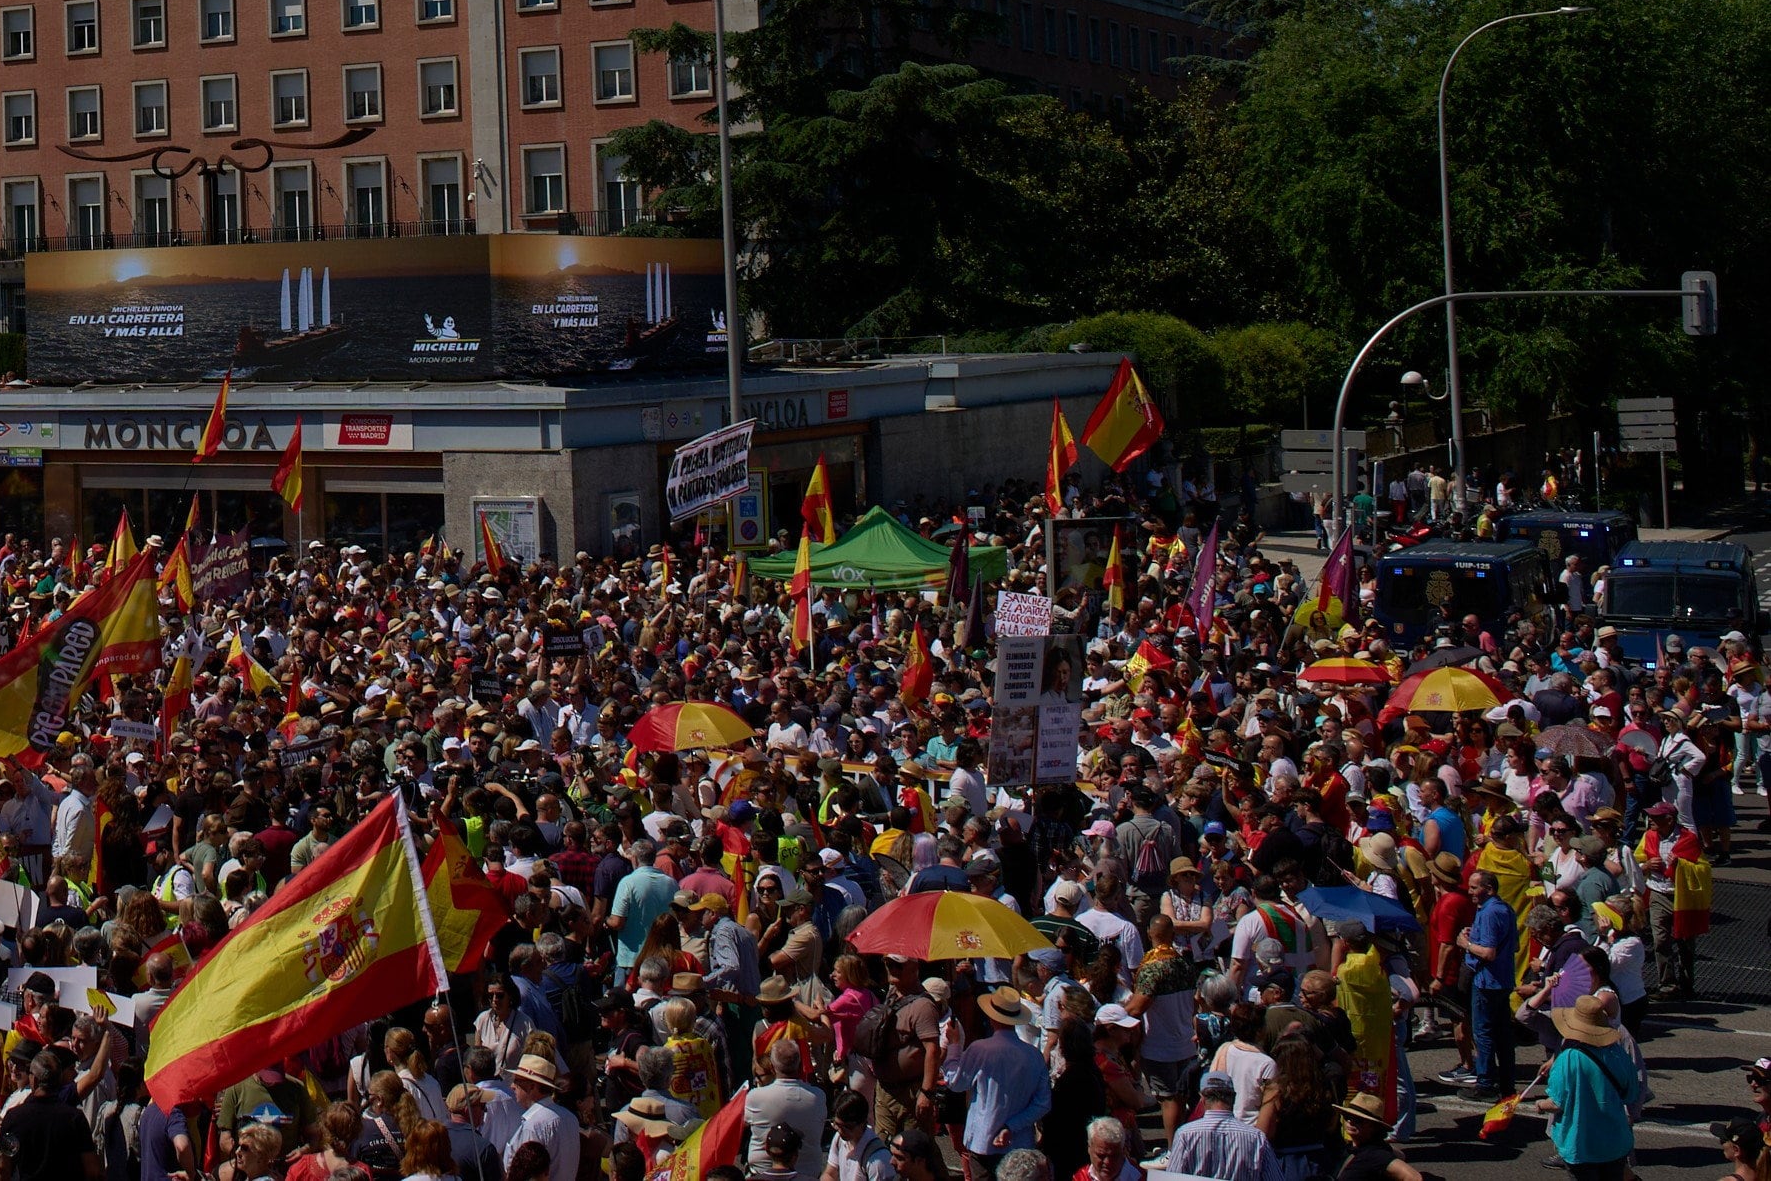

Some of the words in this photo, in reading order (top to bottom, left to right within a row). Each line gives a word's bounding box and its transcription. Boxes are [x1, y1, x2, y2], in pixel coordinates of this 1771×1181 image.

[532, 304, 544, 314] EN
[544, 304, 555, 314] LA
[555, 304, 599, 314] CARRETERA
[69, 315, 87, 325] EN
[89, 315, 105, 324] LA
[108, 313, 184, 324] CARRETERA
[553, 319, 560, 328] Y
[560, 316, 578, 328] MÁS
[579, 315, 599, 327] ALLÁ
[104, 327, 113, 337] Y
[115, 325, 147, 337] MÁS
[148, 324, 184, 336] ALLÁ
[412, 342, 480, 352] MICHELIN
[408, 356, 440, 364] MOTION
[832, 565, 866, 583] VOX
[1000, 602, 1013, 612] EL
[1014, 604, 1050, 617] AYATOLA
